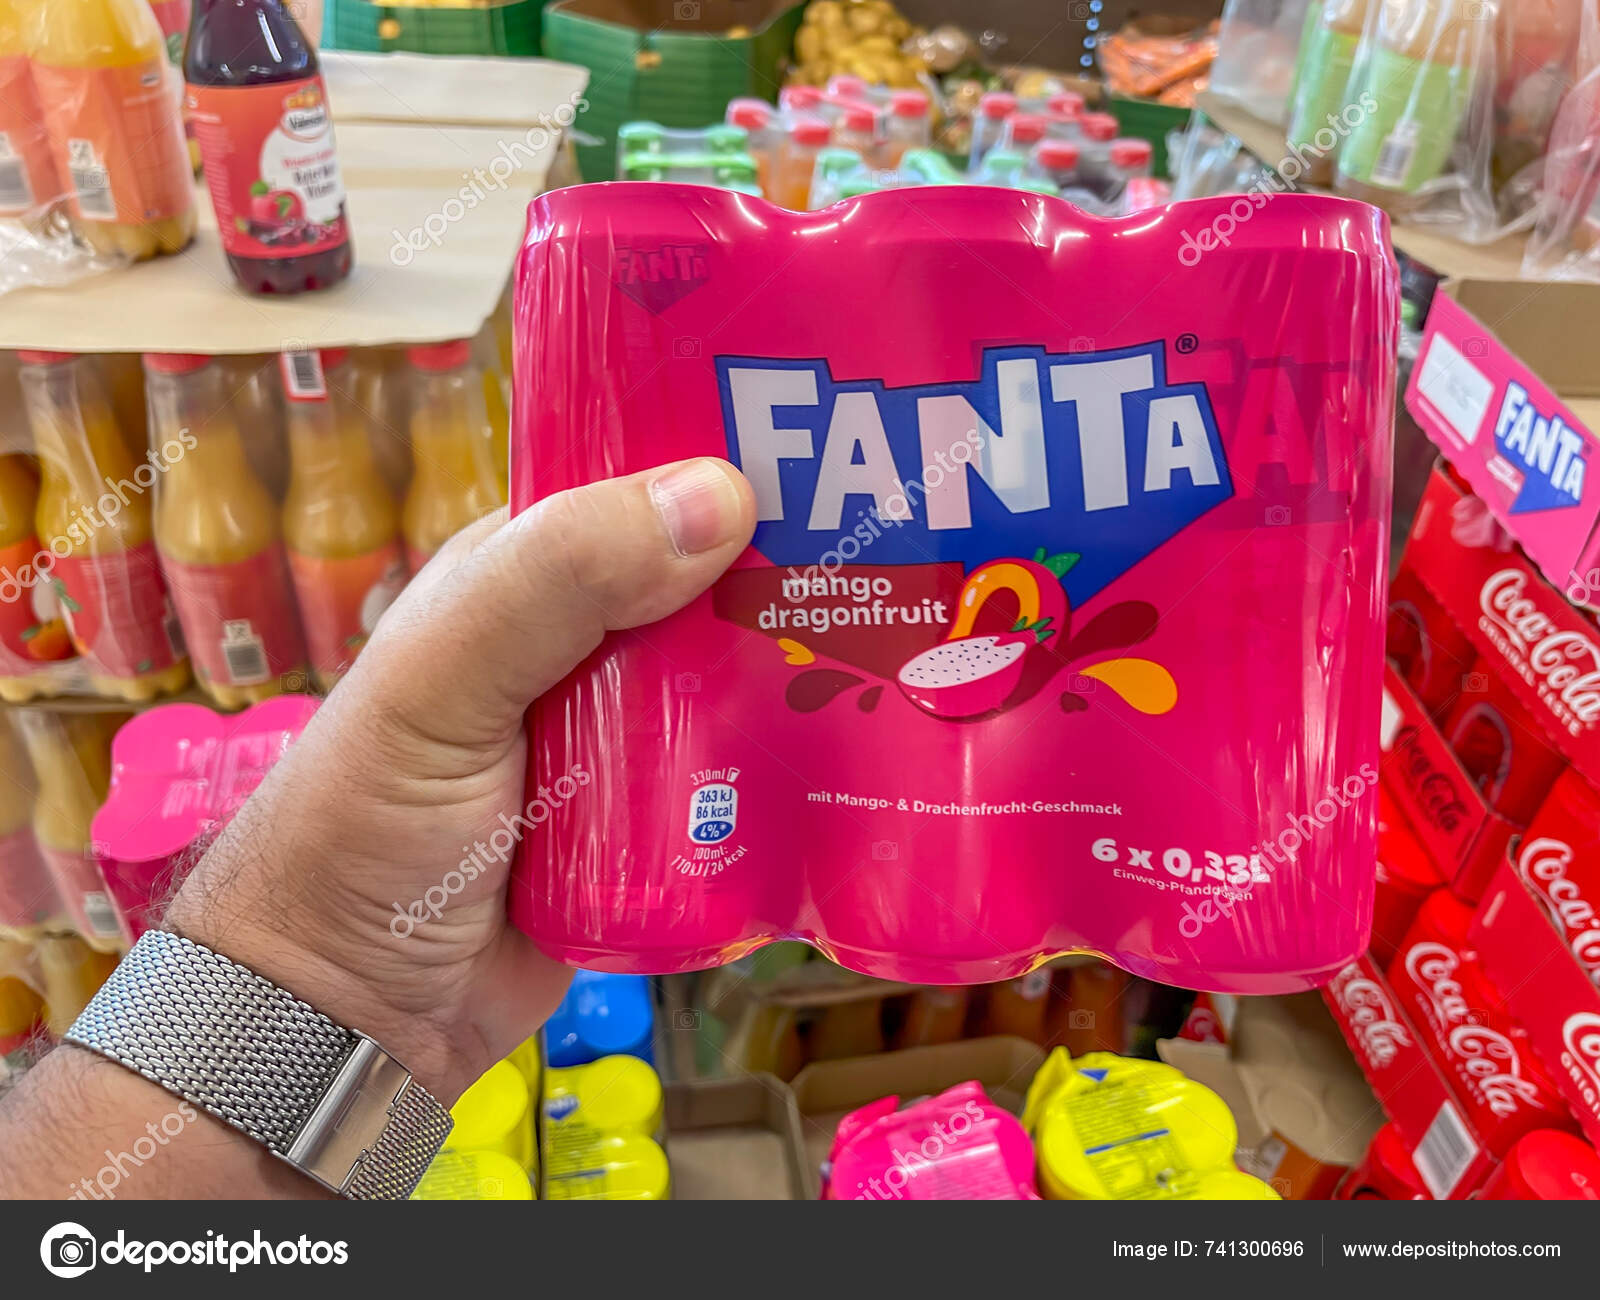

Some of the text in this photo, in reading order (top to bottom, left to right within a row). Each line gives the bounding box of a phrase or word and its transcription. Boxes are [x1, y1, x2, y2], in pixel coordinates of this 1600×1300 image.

[728, 354, 1220, 531] FANTA
[1495, 380, 1586, 501] FANTA
[782, 576, 893, 602] mango
[758, 598, 949, 633] dragonfruit
[1537, 681, 1582, 738] TASTE
[690, 767, 726, 786] 330ml
[699, 788, 733, 803] 363 kJ
[807, 791, 1123, 816] mit Mango- & Drachenfrucht-Geschmack
[696, 803, 734, 819] 86 kcal
[1091, 837, 1119, 862] 6
[1127, 847, 1154, 871] x
